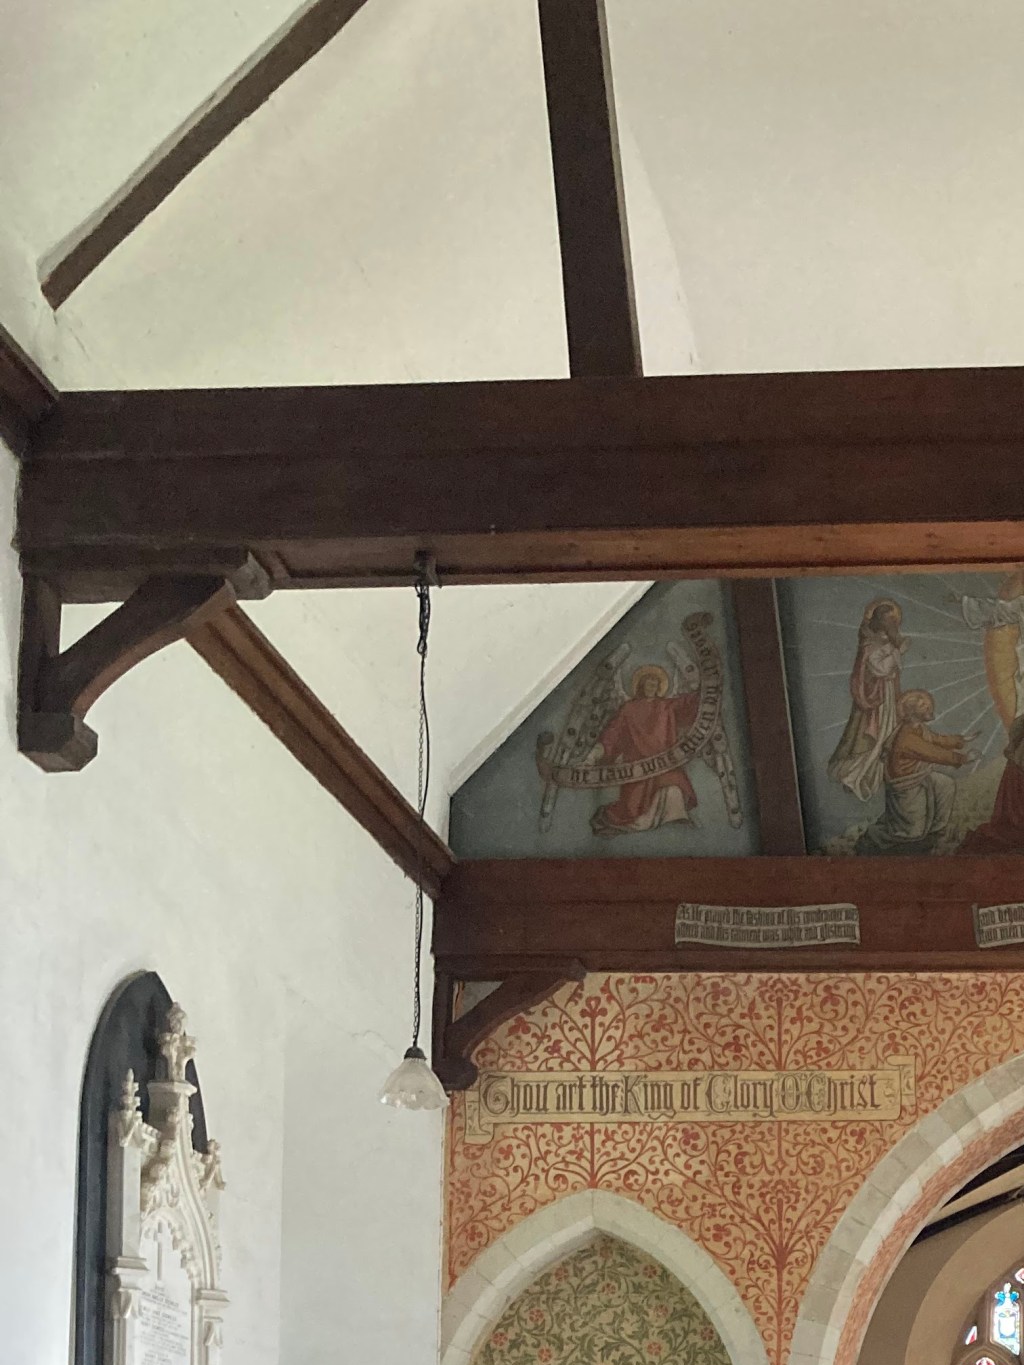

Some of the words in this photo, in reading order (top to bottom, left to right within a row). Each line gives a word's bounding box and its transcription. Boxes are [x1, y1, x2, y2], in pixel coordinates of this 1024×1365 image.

[483, 1074, 549, 1117] Thou
[555, 1075, 587, 1111] art
[590, 1075, 622, 1116] the
[622, 1074, 677, 1120] King
[680, 1076, 703, 1111] of
[704, 1073, 776, 1118] Glory
[780, 1073, 801, 1113] O
[804, 1073, 881, 1115] Christ
